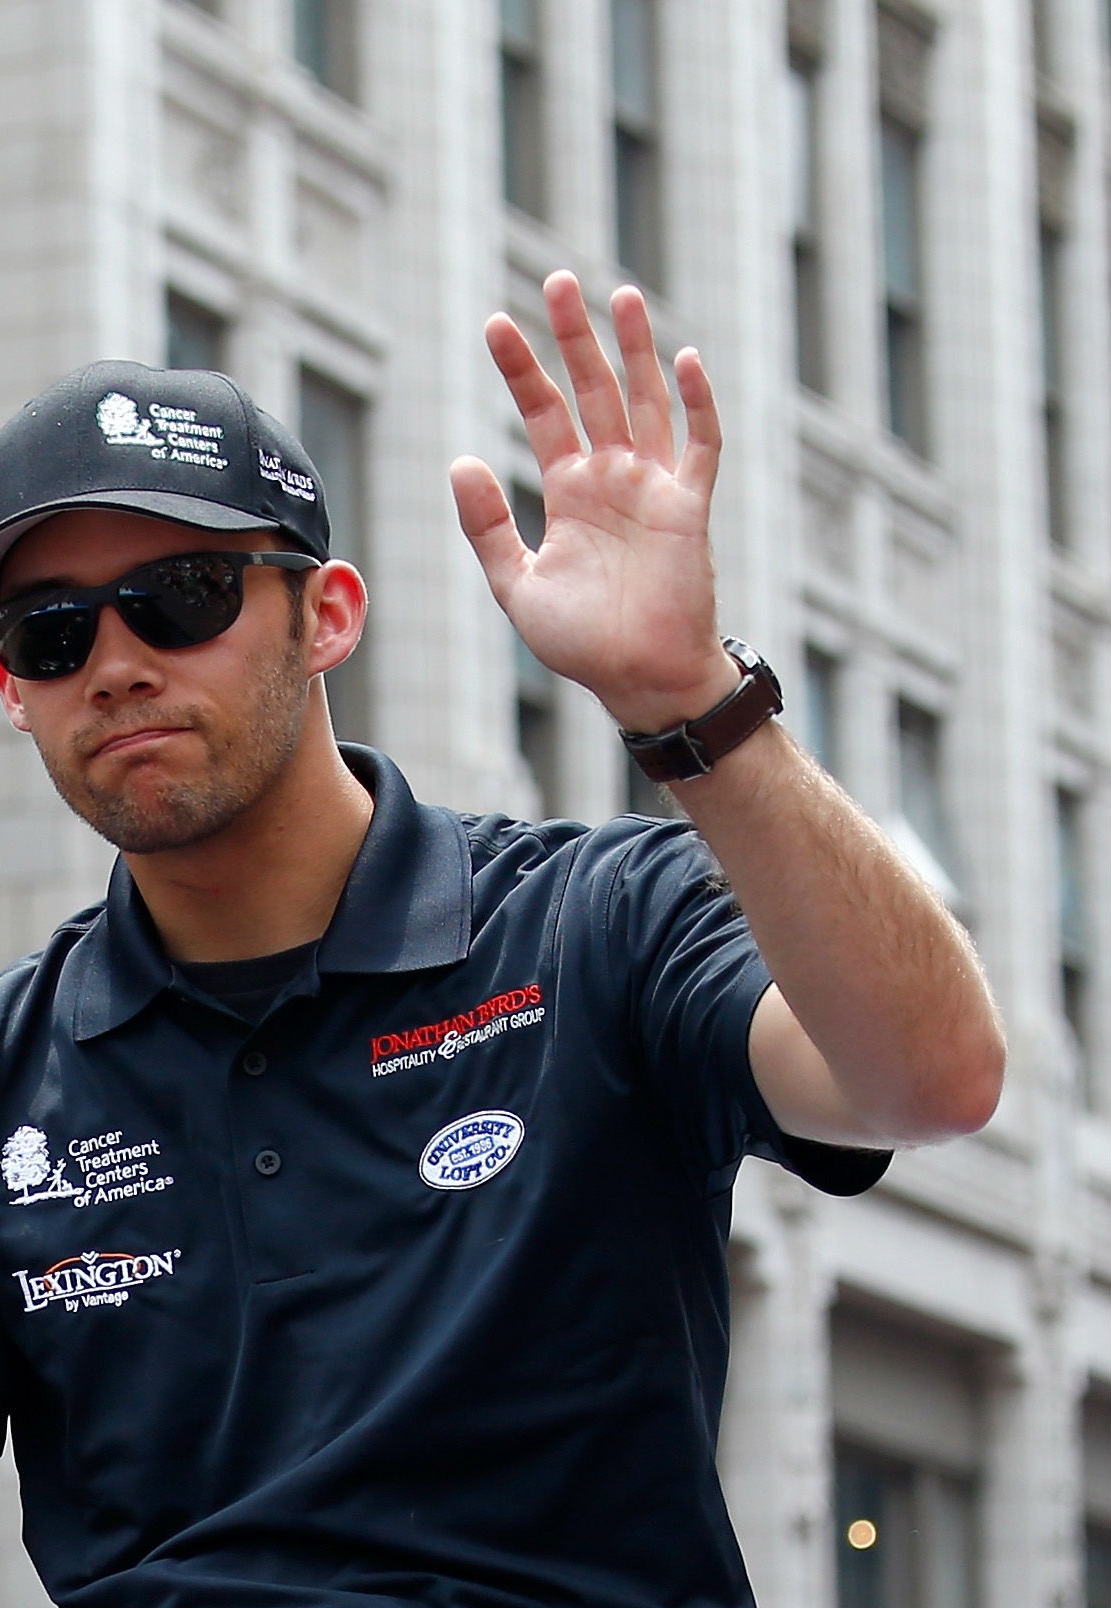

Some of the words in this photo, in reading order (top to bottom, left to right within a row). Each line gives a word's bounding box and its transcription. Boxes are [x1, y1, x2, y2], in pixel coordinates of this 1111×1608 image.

[149, 403, 196, 422] Cancer
[154, 419, 224, 439] Treatment
[151, 446, 168, 459] of
[167, 432, 218, 453] Centers
[371, 1011, 475, 1064] JONATHAN
[372, 1049, 436, 1077] HOSPITALITY
[437, 1030, 461, 1059] &
[510, 1007, 545, 1029] GROUP
[68, 1130, 123, 1157] Cancer
[428, 1120, 515, 1166] UNIVERSITY
[75, 1139, 160, 1173] Treatment
[85, 1162, 149, 1188] Centers
[440, 1161, 482, 1181] LOFT
[73, 1191, 92, 1208] of
[64, 1298, 79, 1312] by
[81, 1290, 130, 1307] Vantage
